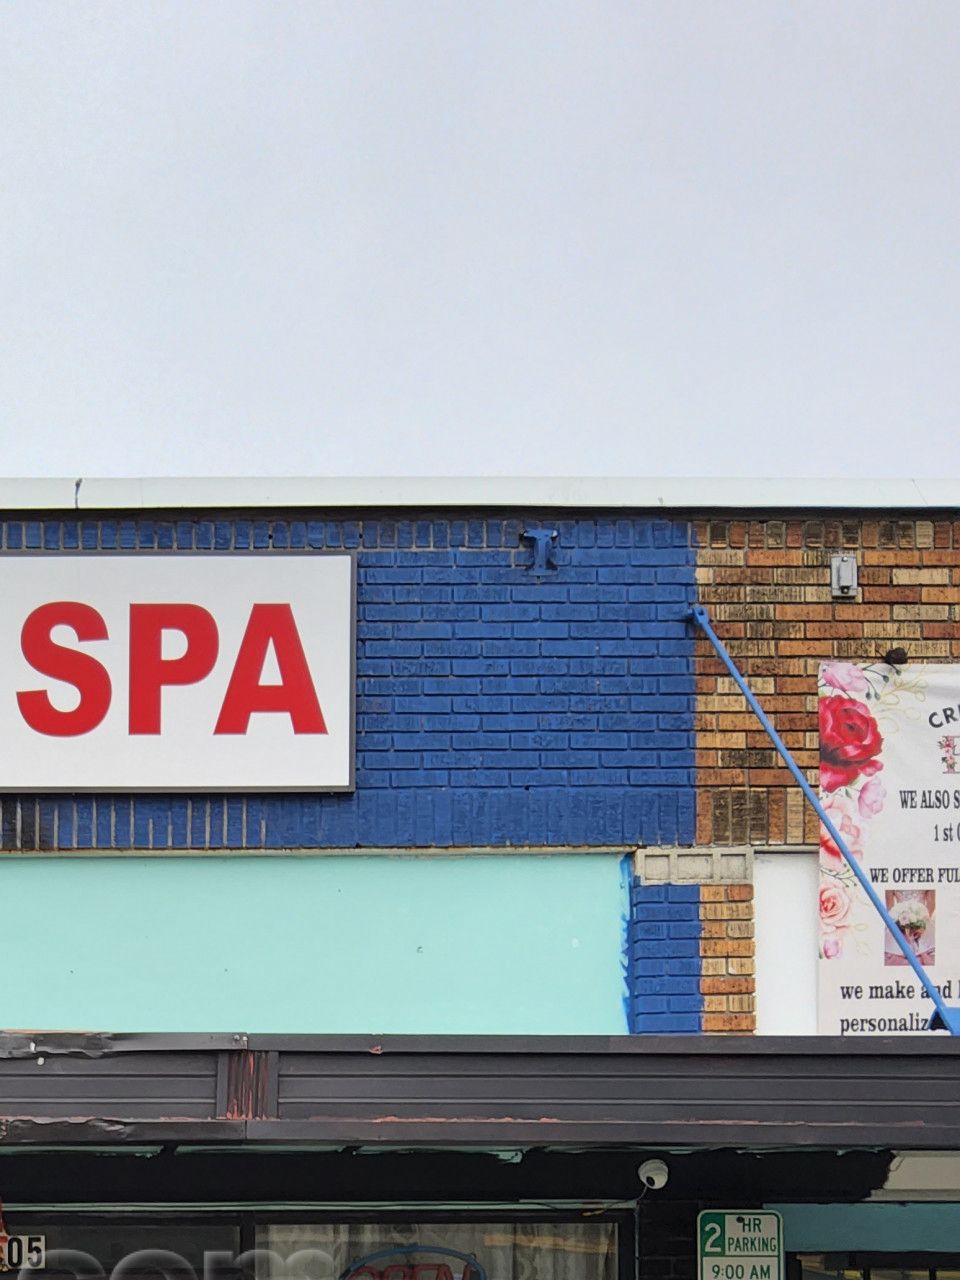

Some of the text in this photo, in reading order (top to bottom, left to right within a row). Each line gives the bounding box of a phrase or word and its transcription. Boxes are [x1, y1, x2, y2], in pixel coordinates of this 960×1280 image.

[15, 600, 329, 738] SPA
[928, 704, 960, 729] CR
[900, 790, 917, 808] WE
[920, 790, 950, 809] ALSO
[870, 868, 889, 883] WE
[892, 868, 934, 883] OFFER
[840, 985, 863, 999] we
[869, 980, 915, 999] make
[704, 1217, 762, 1252] 2 HR
[727, 1237, 777, 1252] PARKING
[711, 1264, 771, 1280] 9:00 AM
